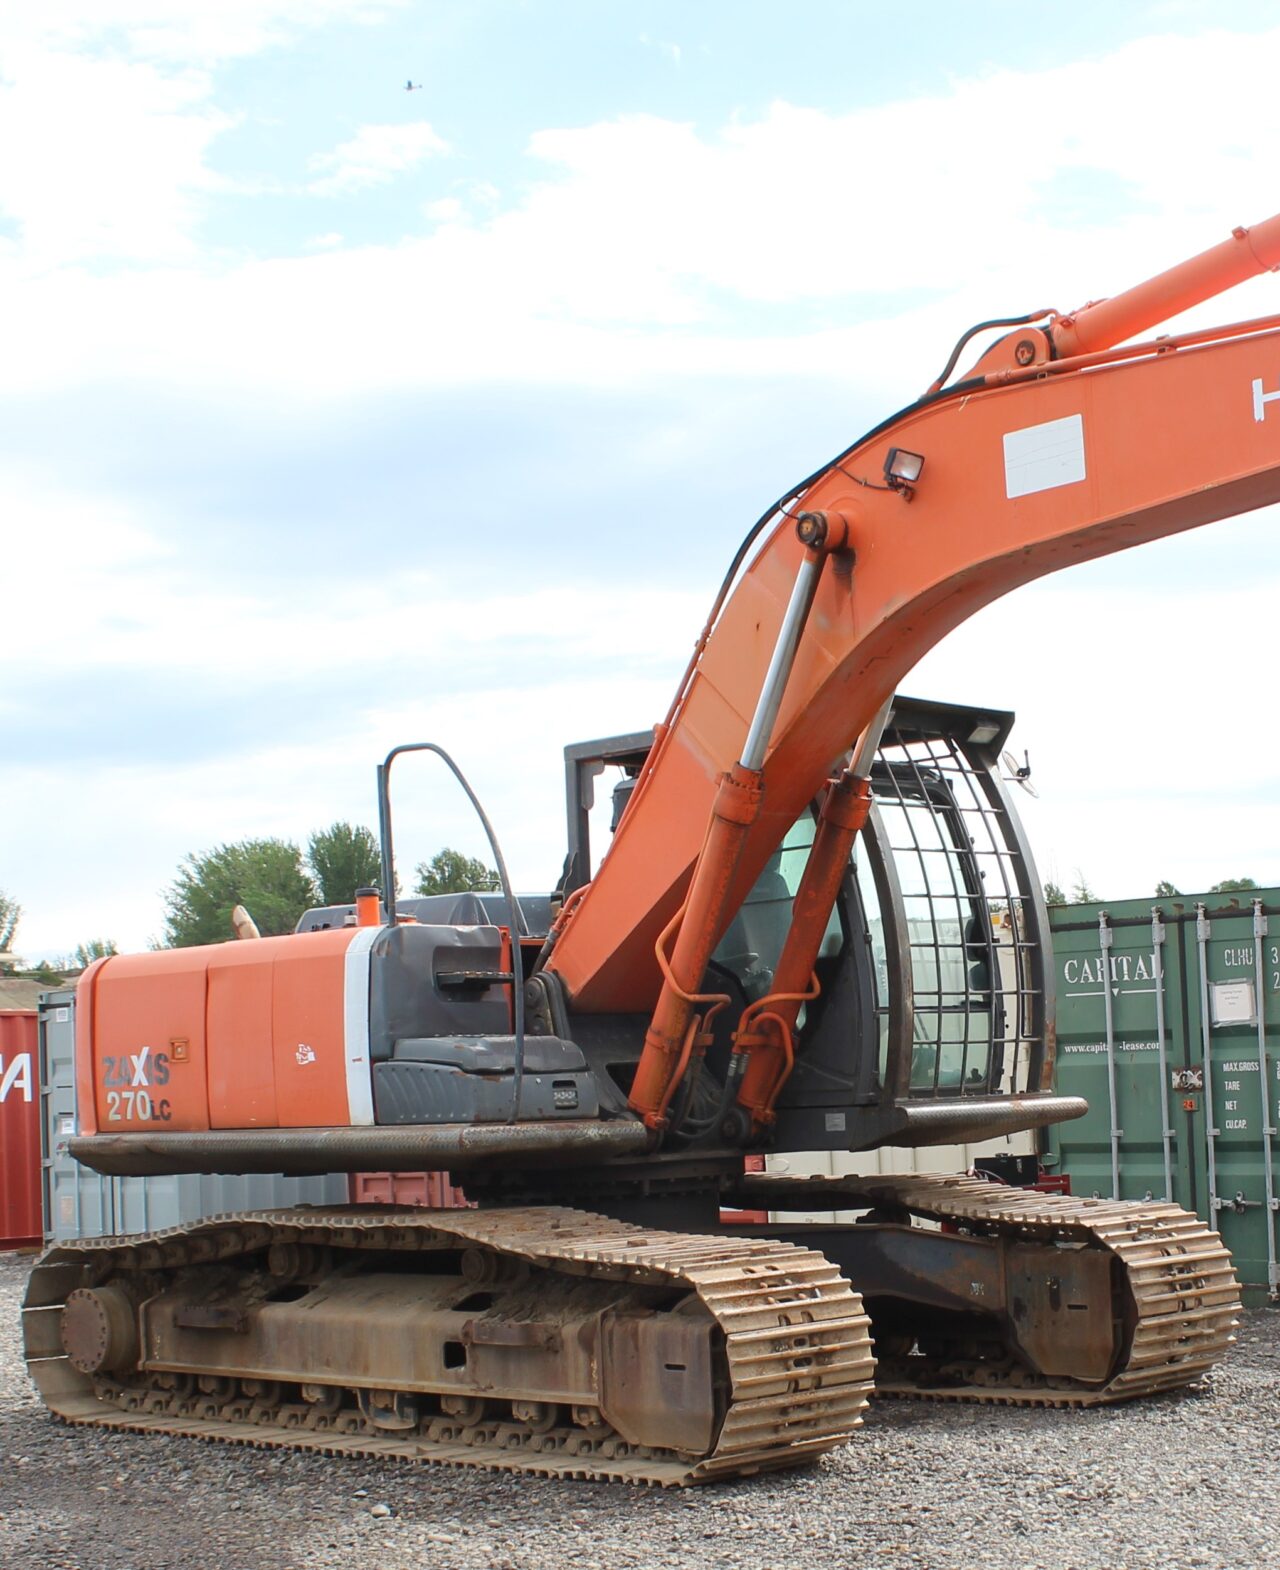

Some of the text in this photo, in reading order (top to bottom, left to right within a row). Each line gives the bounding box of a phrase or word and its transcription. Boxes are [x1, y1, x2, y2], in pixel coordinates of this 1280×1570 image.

[1224, 947, 1253, 966] CLHU
[103, 1046, 170, 1088] ZAXIS
[0, 1052, 32, 1102] A
[1224, 1081, 1240, 1091] TARE
[1225, 1100, 1237, 1111] NET
